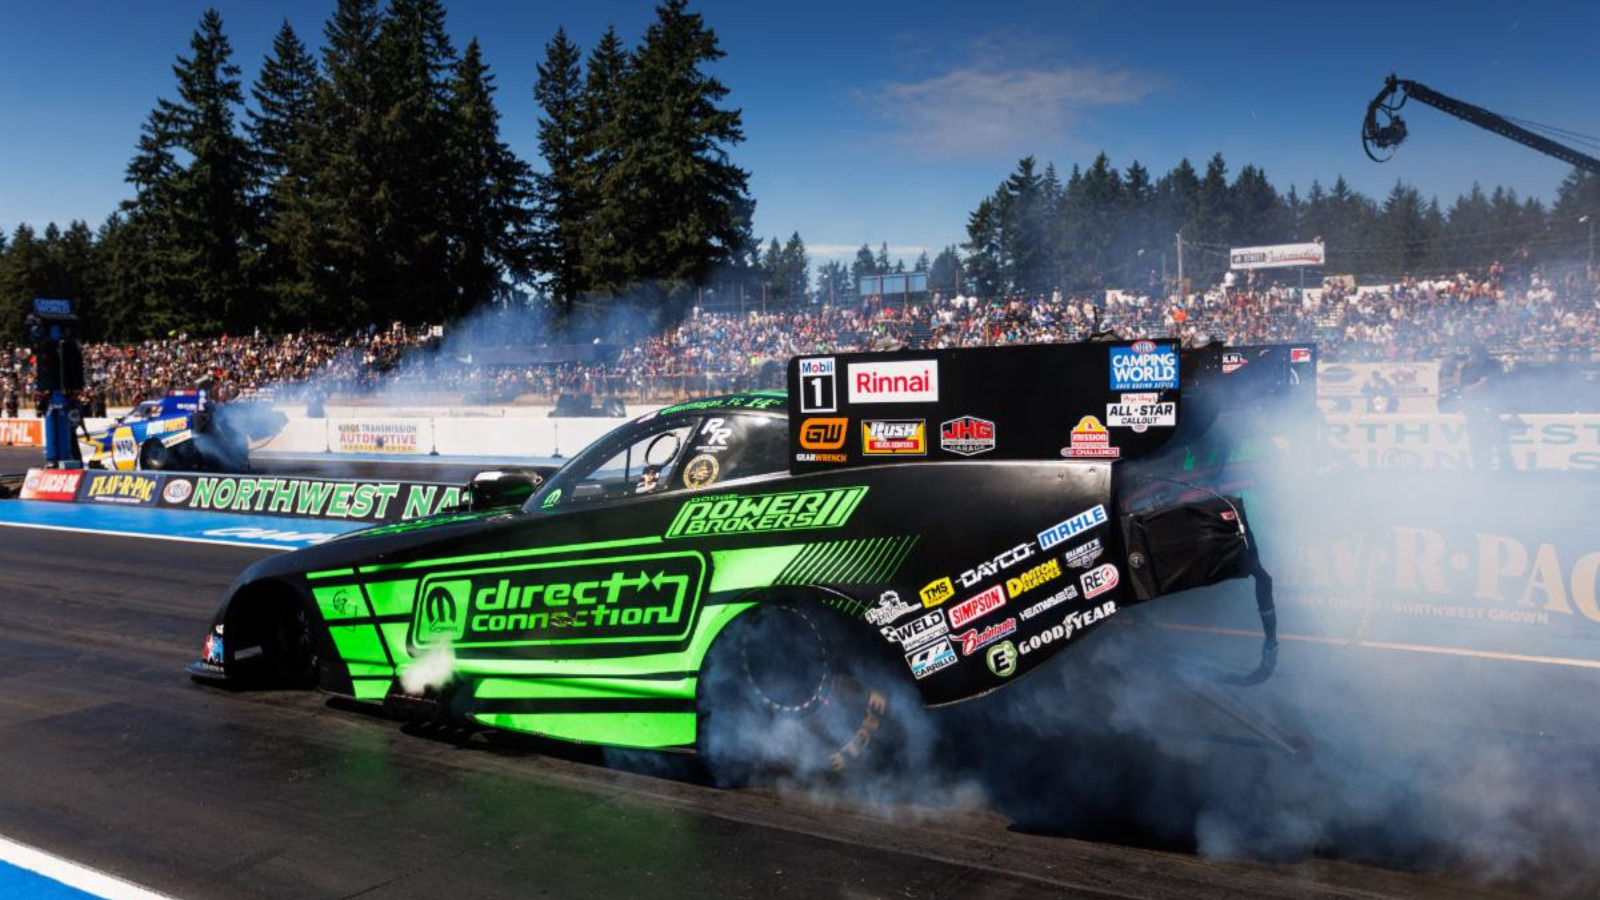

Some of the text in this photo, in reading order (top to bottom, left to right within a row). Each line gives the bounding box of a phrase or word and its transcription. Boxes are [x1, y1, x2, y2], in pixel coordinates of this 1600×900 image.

[802, 361, 833, 374] Mobil
[1112, 353, 1175, 367] CAMPING
[856, 370, 930, 394] Rinnai
[1113, 366, 1175, 382] WORLD
[811, 377, 822, 407] 1
[362, 424, 417, 433] TRANSMISSION
[943, 420, 992, 440] JHG
[1121, 416, 1158, 424] CALLOUT
[806, 424, 844, 443] GW
[796, 453, 848, 463] GEARWRENCH
[189, 477, 400, 519] NORTHWEST
[401, 484, 473, 519] NA
[690, 492, 827, 520] POWER
[691, 493, 739, 503] DODGE
[684, 513, 818, 535] BROKERS
[1040, 507, 1105, 547] MAHLE
[956, 542, 1034, 588] DAYCO
[476, 571, 650, 611] direct
[924, 581, 948, 600] TMS
[952, 588, 1000, 625] SIMPSON
[471, 604, 679, 632] connection
[896, 612, 944, 641] WELD
[1018, 600, 1117, 655] GOODYEAR
[915, 656, 956, 678] CARRILLO
